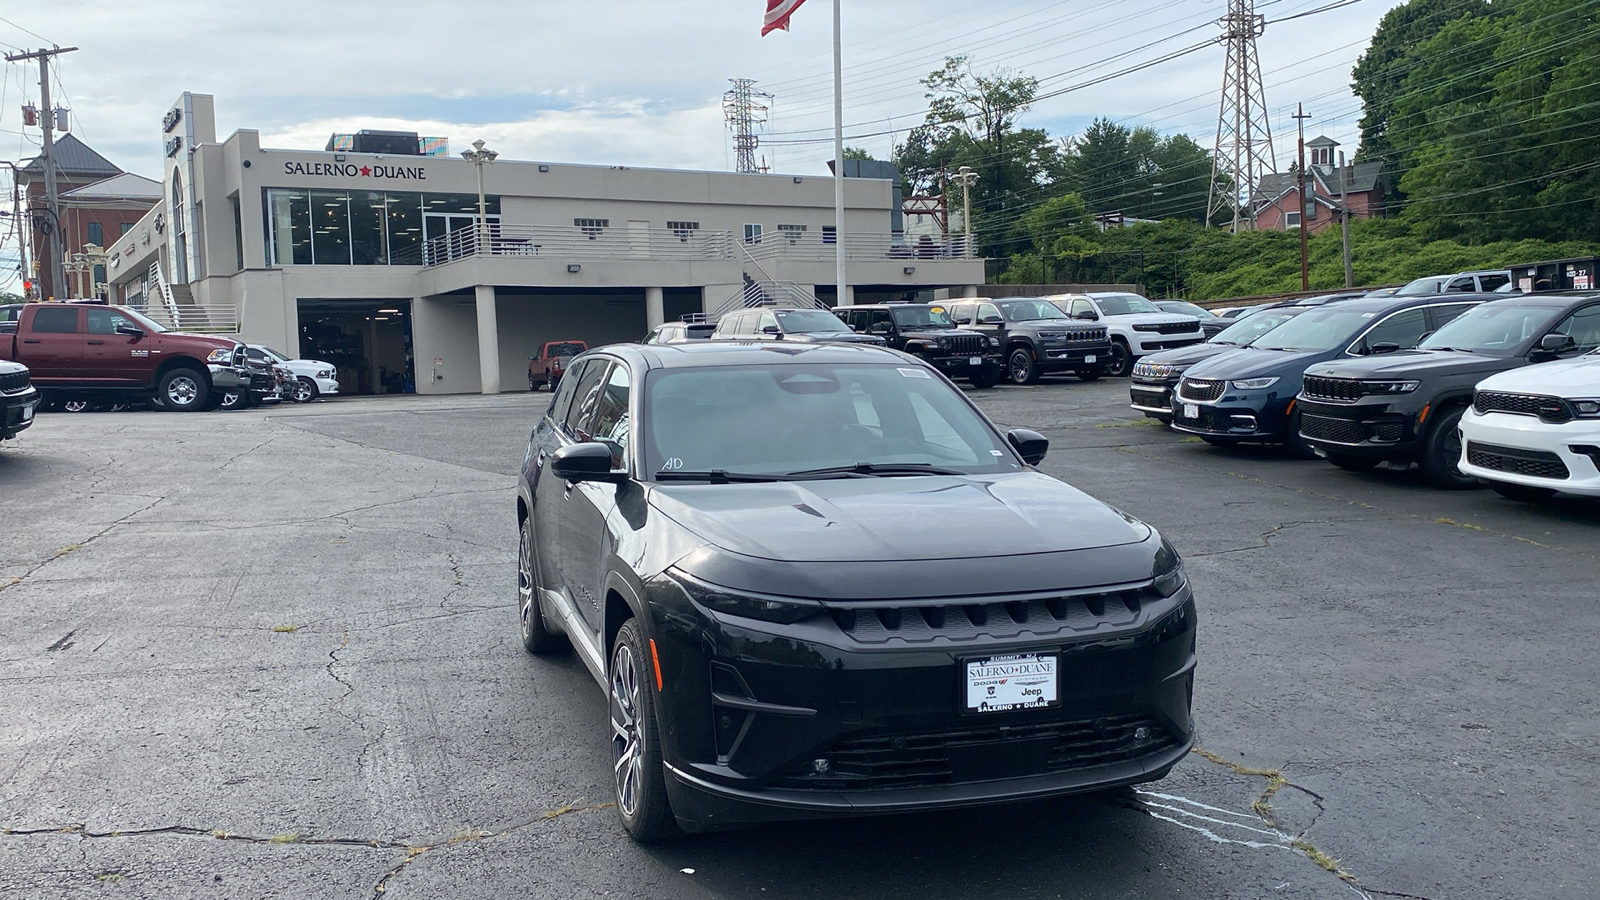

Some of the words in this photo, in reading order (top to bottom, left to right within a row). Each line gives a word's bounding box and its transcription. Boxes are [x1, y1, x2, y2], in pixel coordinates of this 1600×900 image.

[284, 162, 358, 177] SALERNO
[373, 165, 426, 180] DUANE
[969, 665, 1014, 678] SALERNO
[1019, 663, 1053, 674] DUANE
[1021, 688, 1042, 696] Jeep
[977, 703, 1013, 713] SALERNO
[1023, 701, 1049, 709] DUANE
